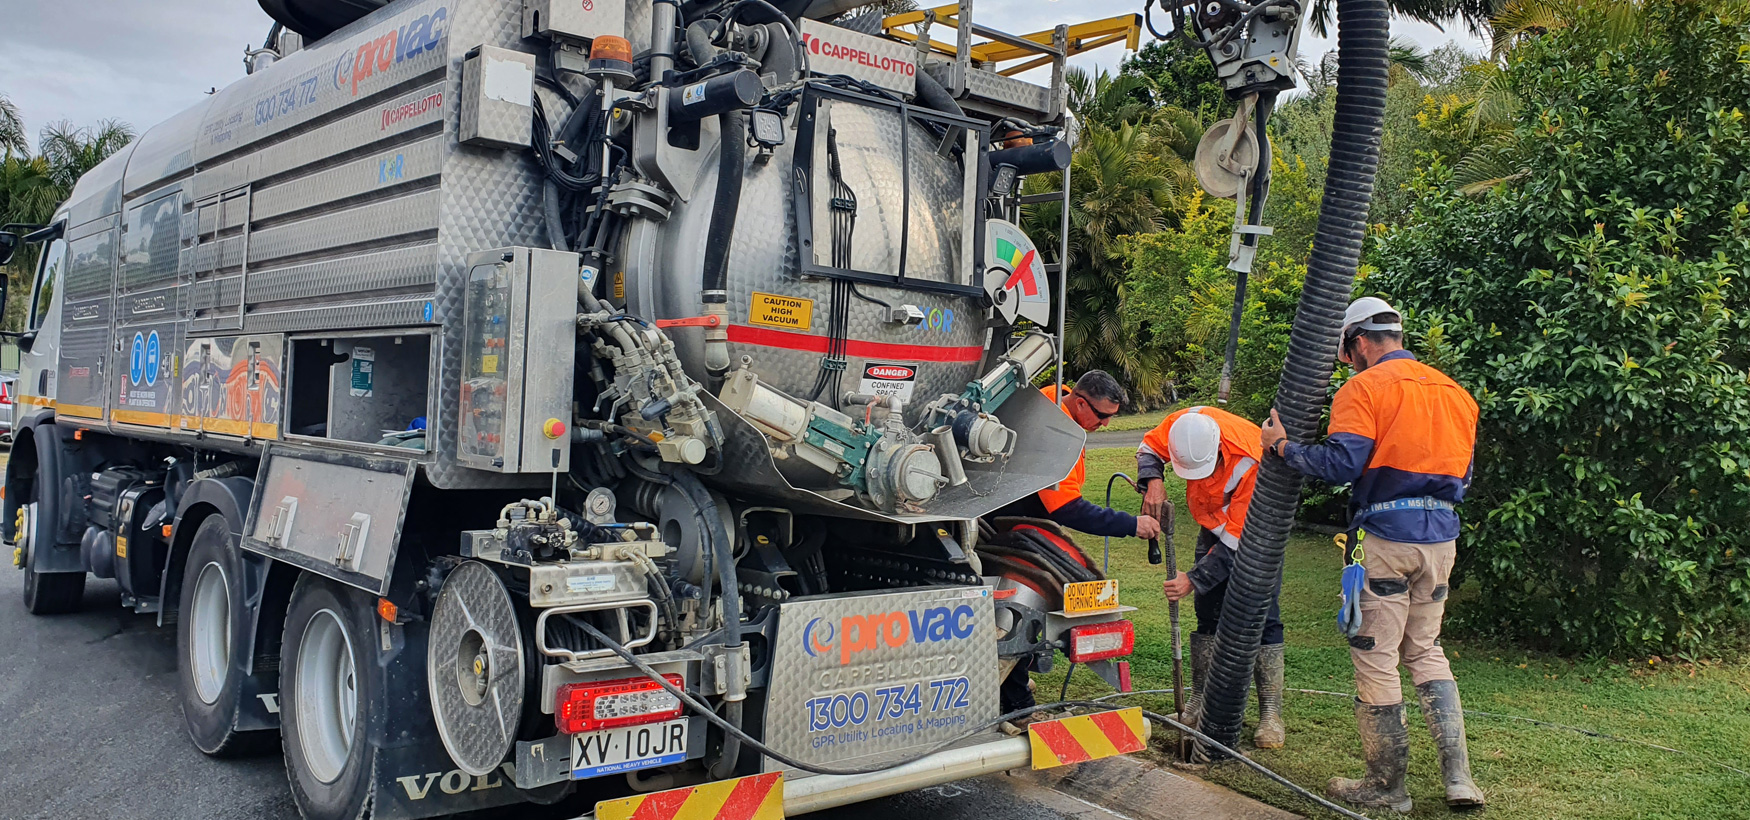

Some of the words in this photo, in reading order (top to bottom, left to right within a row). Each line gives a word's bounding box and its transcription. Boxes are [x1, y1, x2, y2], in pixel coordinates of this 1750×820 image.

[821, 41, 915, 76] CAPPELLOTTO
[255, 95, 276, 126] 1300
[278, 85, 298, 116] 734
[300, 76, 318, 107] 772
[391, 92, 442, 124] CAPPELLOTTO
[763, 297, 802, 308] CAUTION
[771, 307, 793, 316] HIGH
[762, 314, 799, 325] VACUUM
[873, 368, 908, 377] DANGER
[871, 381, 905, 390] CONFINED
[1370, 500, 1397, 511] IMET
[1067, 585, 1076, 597] DO
[1077, 583, 1088, 596] NOT
[1069, 596, 1092, 610] TURNING
[840, 605, 974, 665] provac
[820, 655, 958, 688] CAPPELLOTTO
[805, 690, 869, 732] 1300
[875, 683, 922, 721] 734
[930, 676, 970, 712] 772
[812, 735, 835, 748] GPR
[839, 730, 868, 743] Utility
[872, 723, 913, 738] Locating
[917, 720, 924, 729] &
[926, 714, 965, 729] Mapping
[596, 764, 622, 773] NATIONAL
[623, 761, 640, 769] HEAVY
[641, 758, 662, 766] VEHICLE
